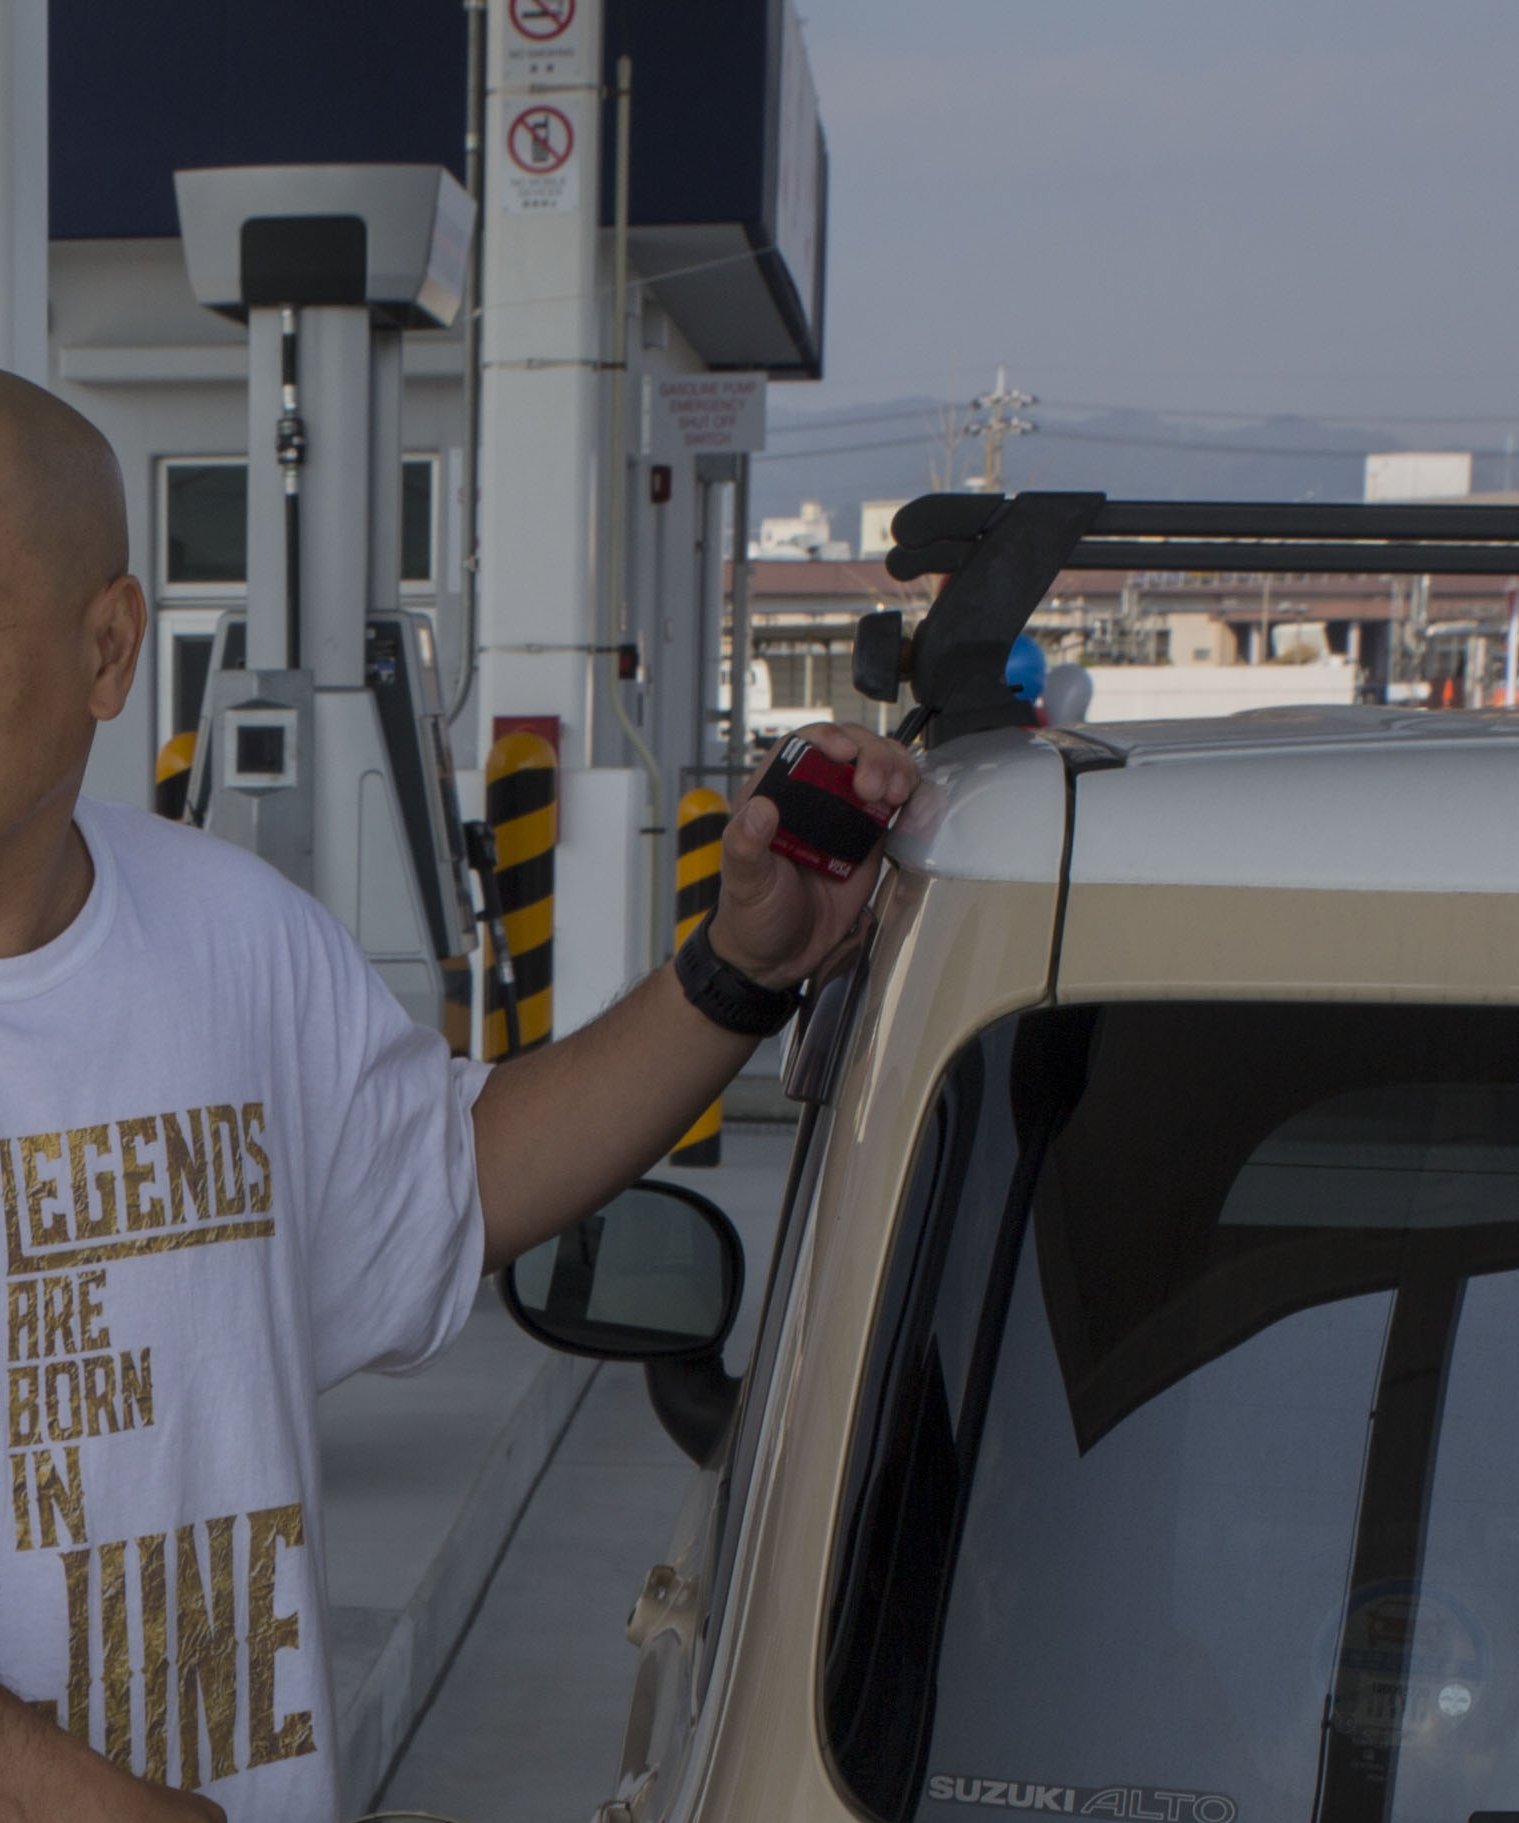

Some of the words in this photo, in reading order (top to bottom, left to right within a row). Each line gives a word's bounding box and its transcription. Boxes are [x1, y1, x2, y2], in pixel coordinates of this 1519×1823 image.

[828, 858, 851, 878] VISA
[6, 1269, 111, 1361] ARE
[6, 1347, 154, 1447] BORN
[12, 1446, 88, 1552] IN
[34, 1504, 317, 1793] JUNE
[927, 1775, 1075, 1814] SUZUKI
